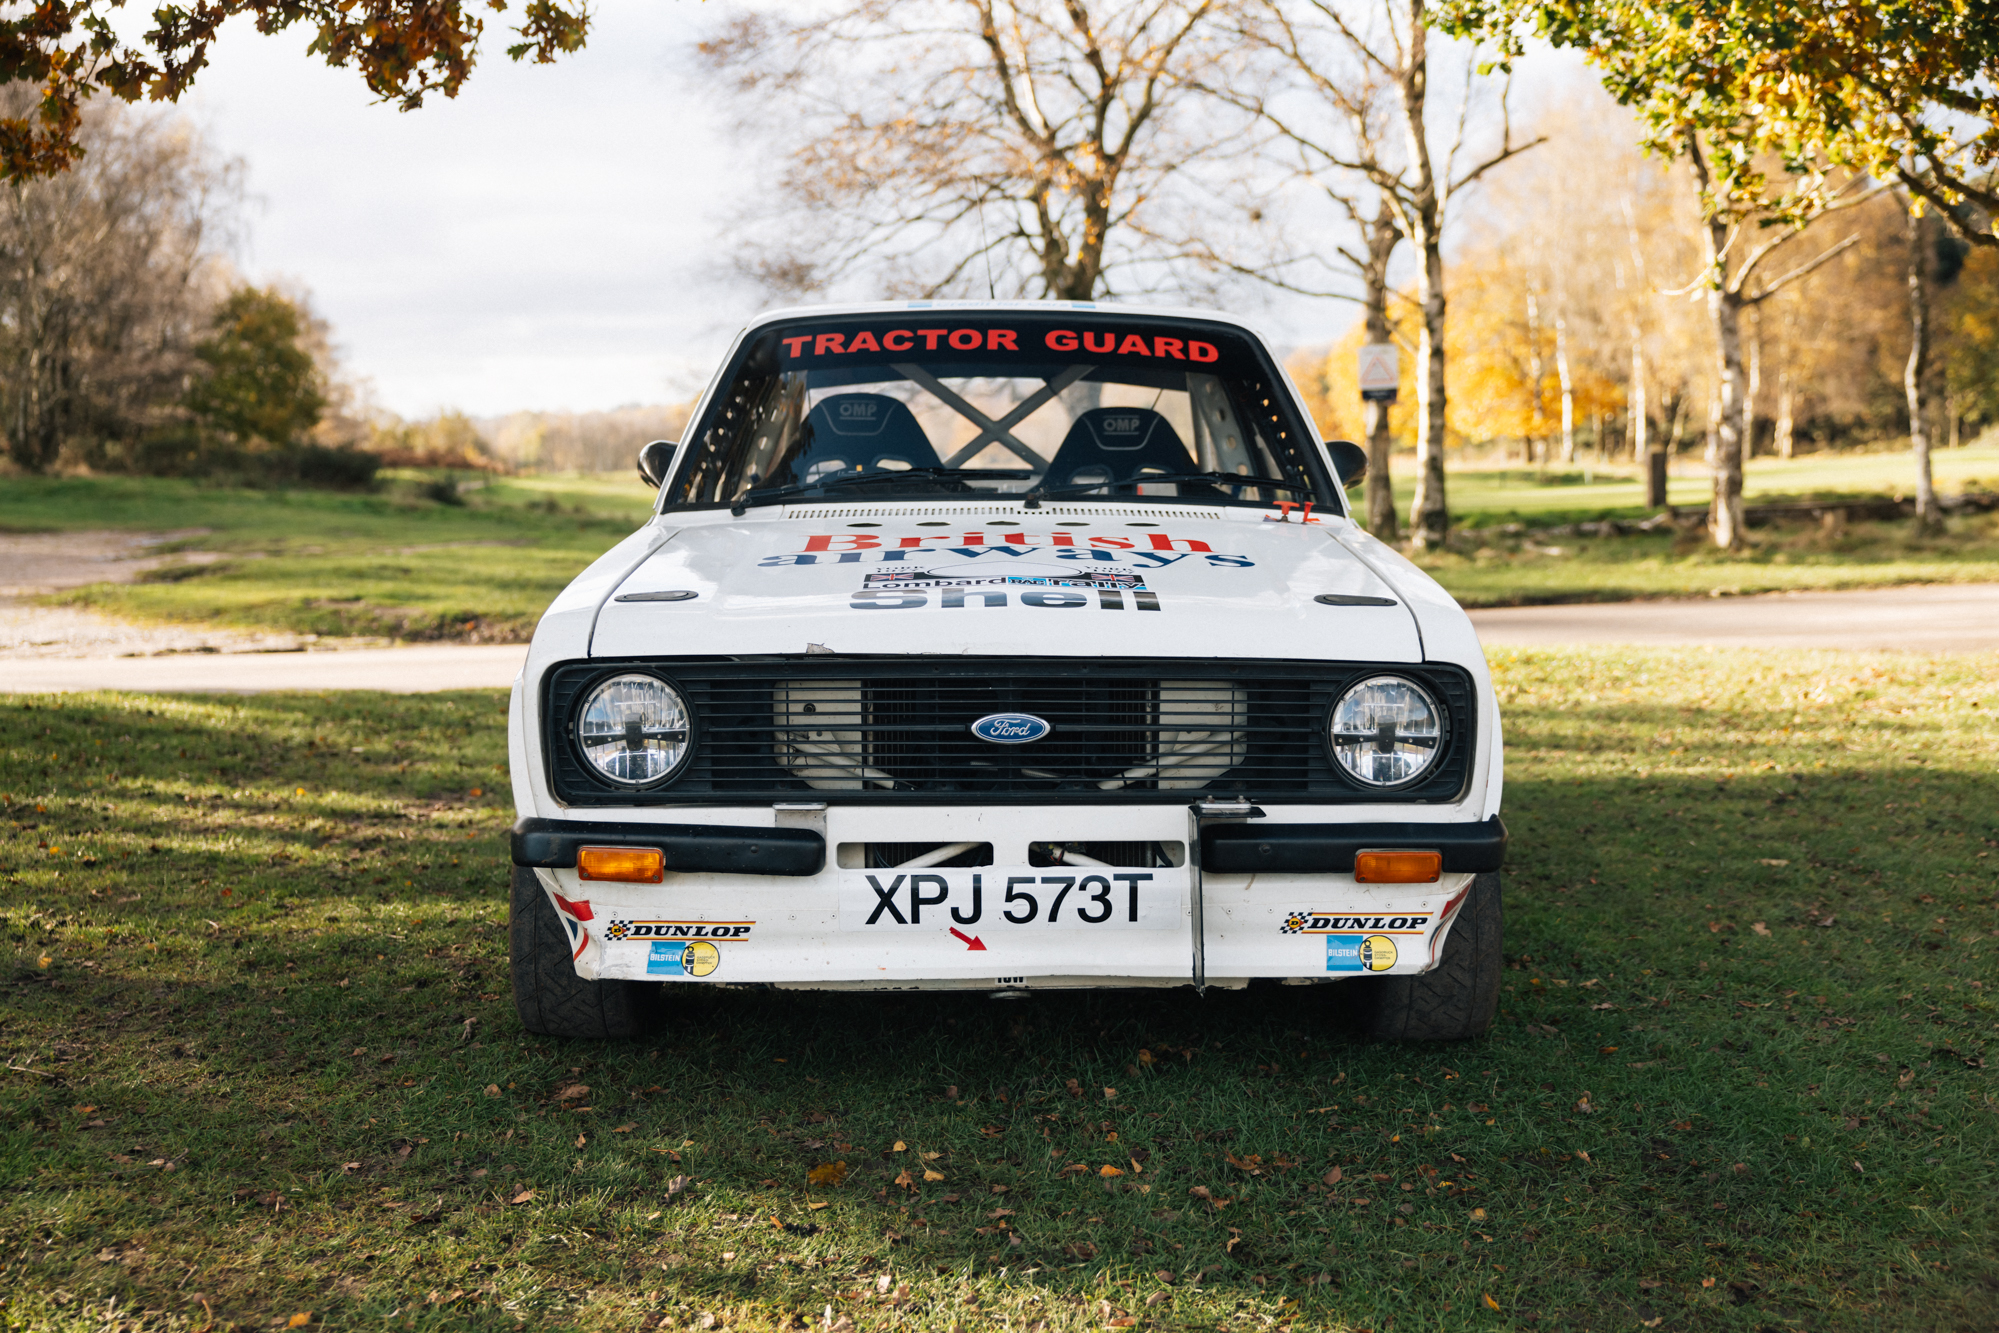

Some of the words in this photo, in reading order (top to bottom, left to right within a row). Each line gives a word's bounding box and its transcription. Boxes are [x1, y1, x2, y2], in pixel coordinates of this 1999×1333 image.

[782, 328, 1019, 358] TRACTOR
[1044, 329, 1219, 363] GUARD
[840, 403, 877, 416] OMP
[1103, 419, 1140, 431] OMP
[800, 531, 1214, 553] British
[757, 546, 1256, 568] airways
[863, 577, 1006, 589] Lombard
[1051, 579, 1147, 590] rally
[849, 587, 1162, 612] Shell
[990, 719, 1031, 736] Ford
[865, 873, 982, 925] XPJ
[1002, 873, 1154, 925] 573T
[1307, 917, 1428, 930] DUNLOP
[630, 925, 751, 937] DUNLOP
[650, 953, 680, 962] BILSTEIN
[1328, 948, 1358, 957] BILSTEIN
